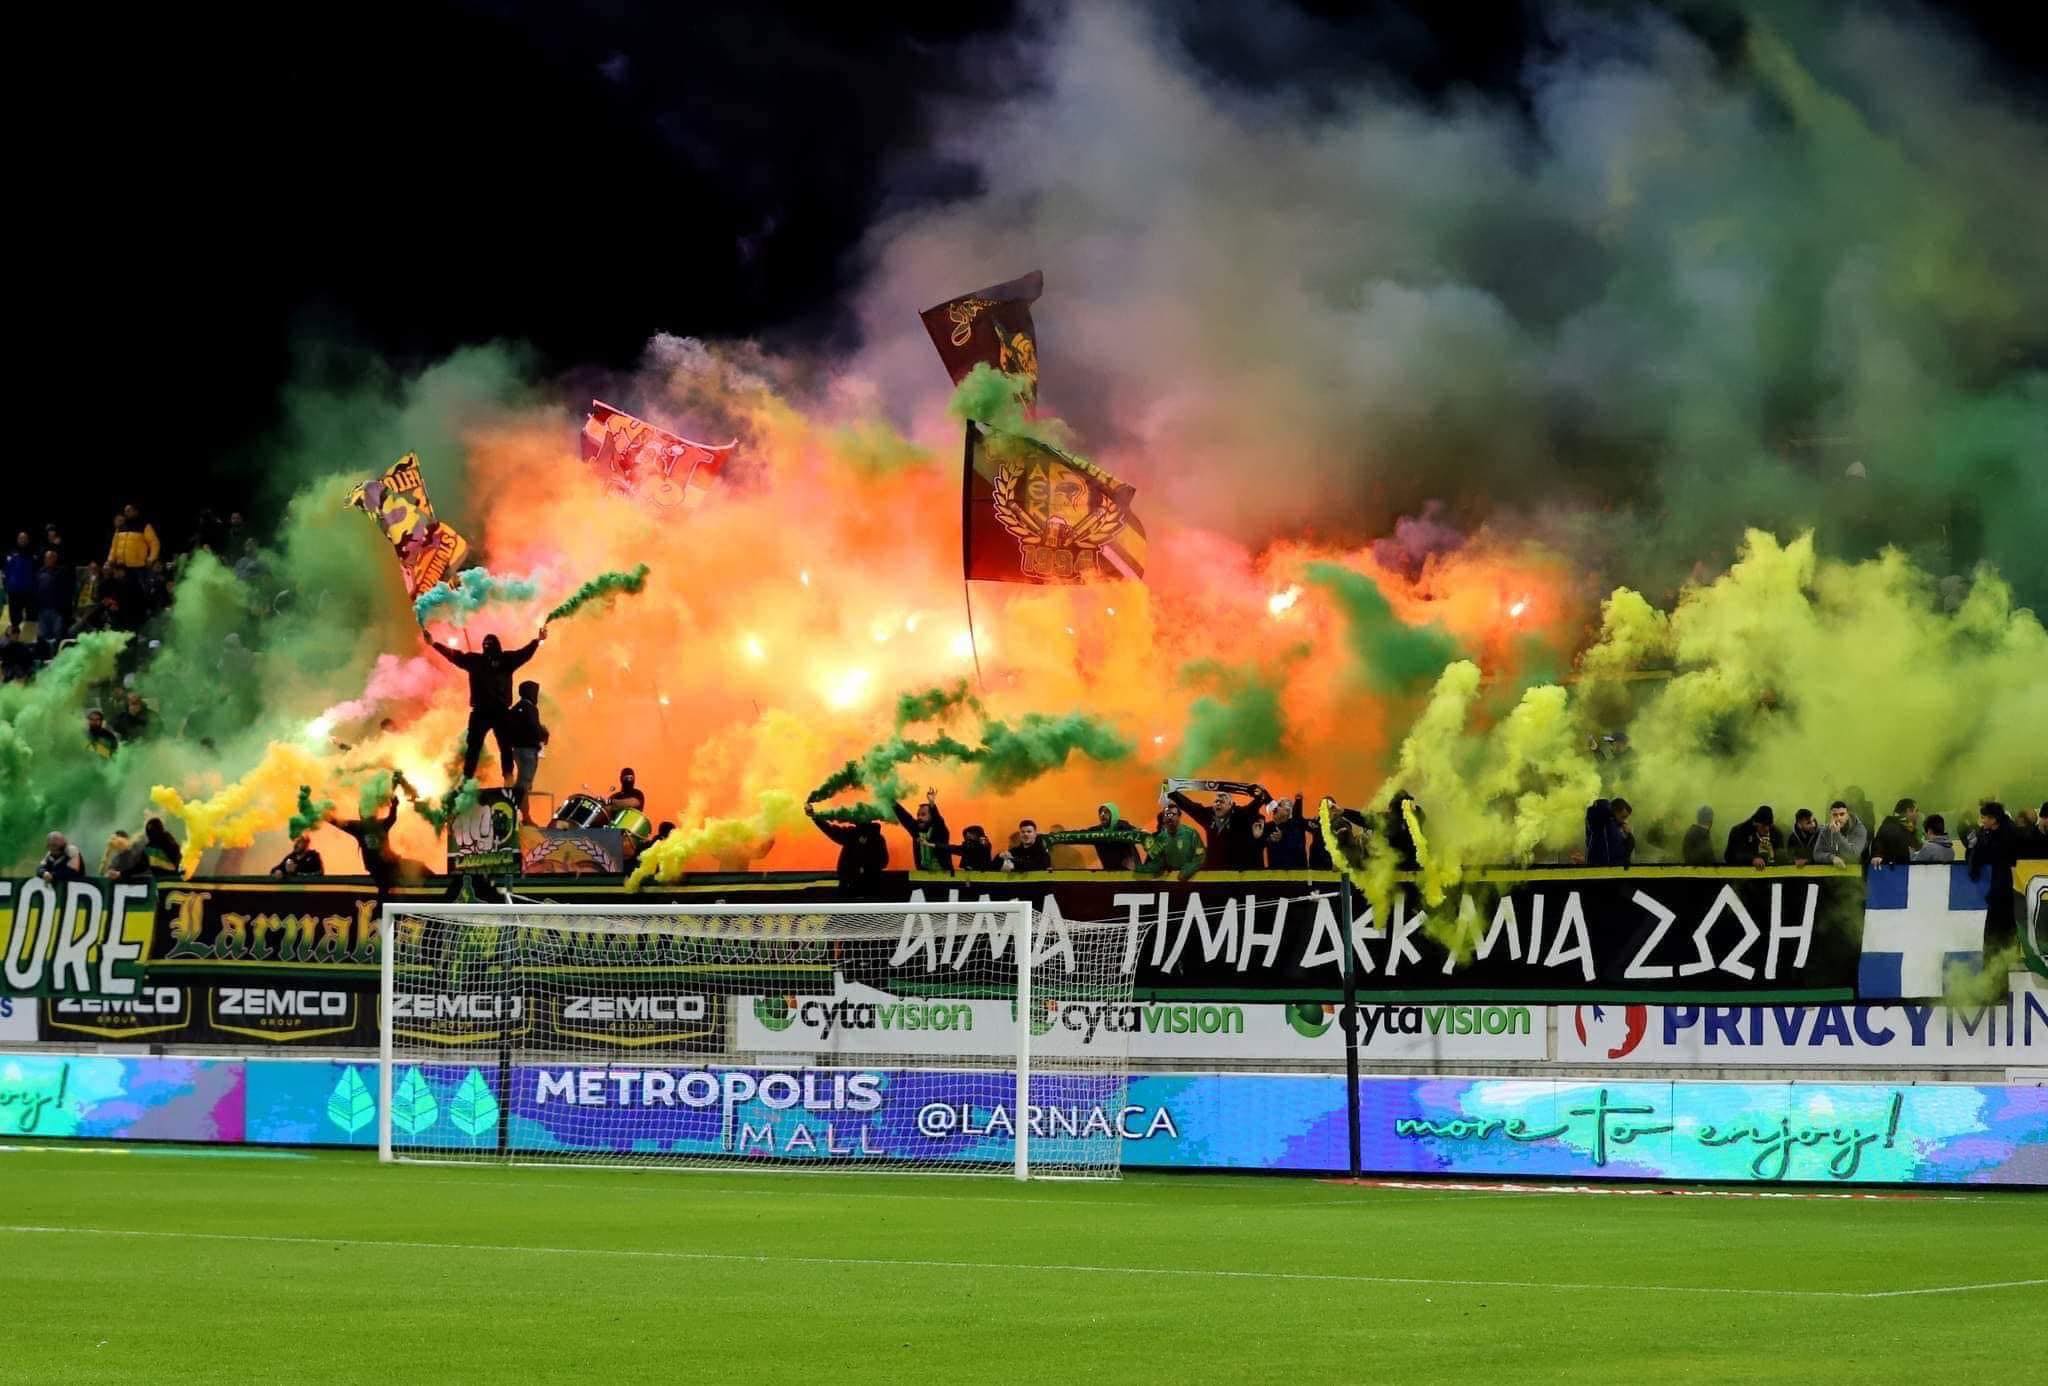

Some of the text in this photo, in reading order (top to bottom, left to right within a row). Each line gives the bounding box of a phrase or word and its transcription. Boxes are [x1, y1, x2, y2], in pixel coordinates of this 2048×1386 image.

[0, 877, 148, 994] ORE
[1113, 892, 1287, 974] ΤΙΜΗ
[1442, 891, 1596, 982] ΜΙΑ
[1624, 883, 1819, 981] ΖΩΗ
[218, 988, 347, 1016] ZEMCO
[260, 1018, 301, 1026] GROUP
[563, 996, 706, 1020] ZEMCO
[801, 998, 973, 1040] cytavision
[1062, 1004, 1244, 1044] cytavision
[537, 1070, 882, 1150] METROPOLIS
[740, 1122, 886, 1153] MALL
[1395, 1089, 1904, 1181] more to enjoy!
